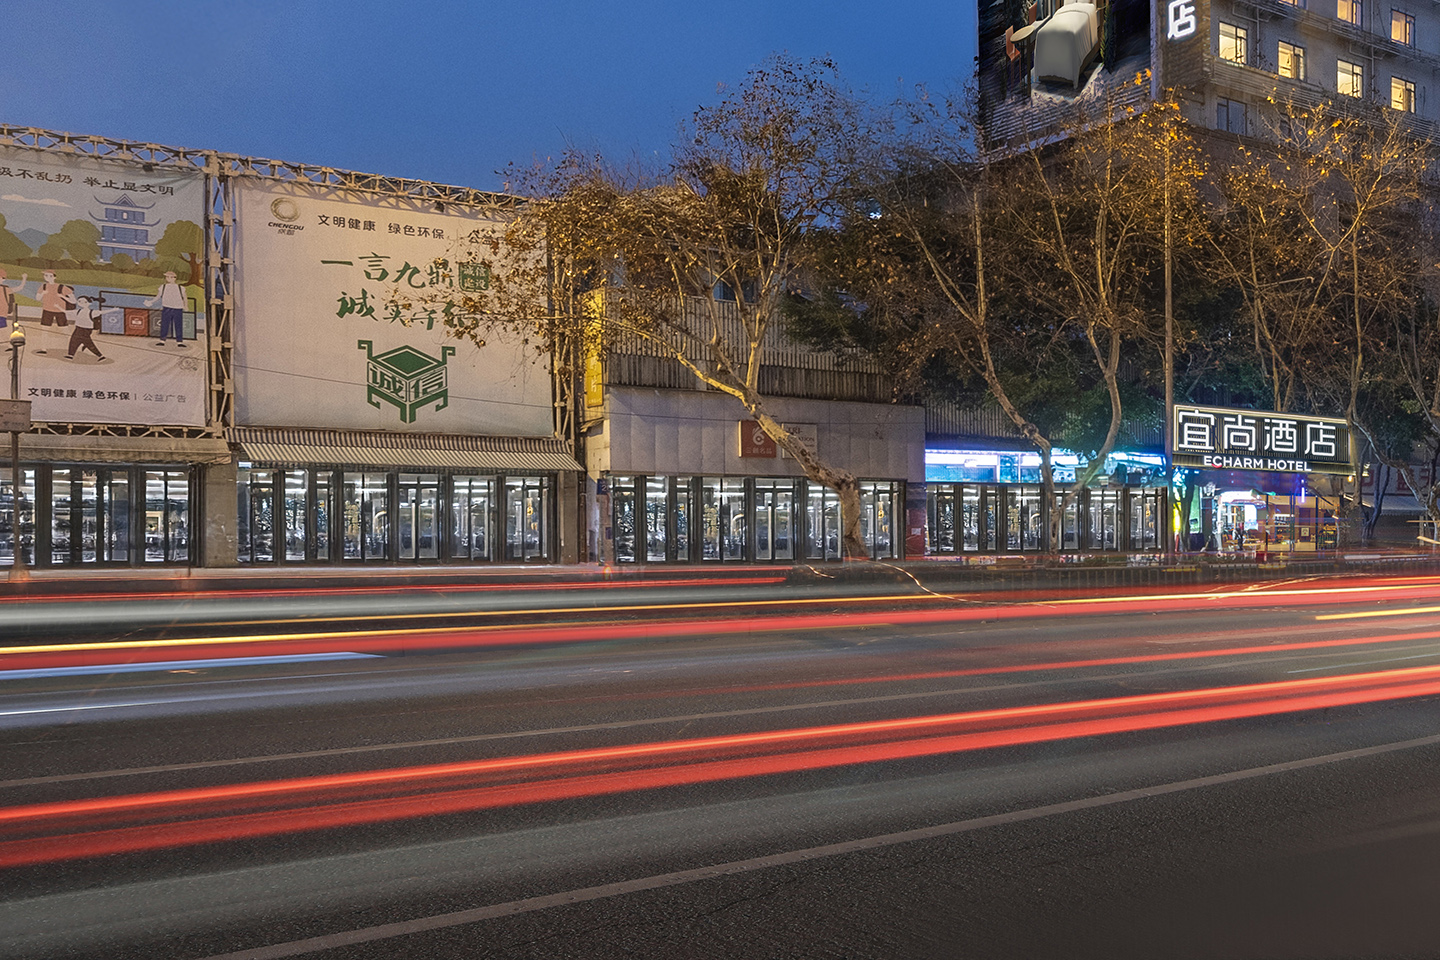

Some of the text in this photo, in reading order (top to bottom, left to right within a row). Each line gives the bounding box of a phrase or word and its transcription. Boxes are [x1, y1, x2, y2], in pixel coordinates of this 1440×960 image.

[83, 176, 174, 196] 举止显文明
[317, 214, 377, 231] 文明健康
[387, 222, 445, 240] 绿色环保
[320, 252, 454, 289] 一言九鼎
[28, 387, 187, 403] 文明健康 绿色环保 公益广告
[370, 363, 444, 401] 诚信
[1178, 409, 1336, 457] 宜尚酒店
[1204, 455, 1312, 472] ECHARM HOTEL
